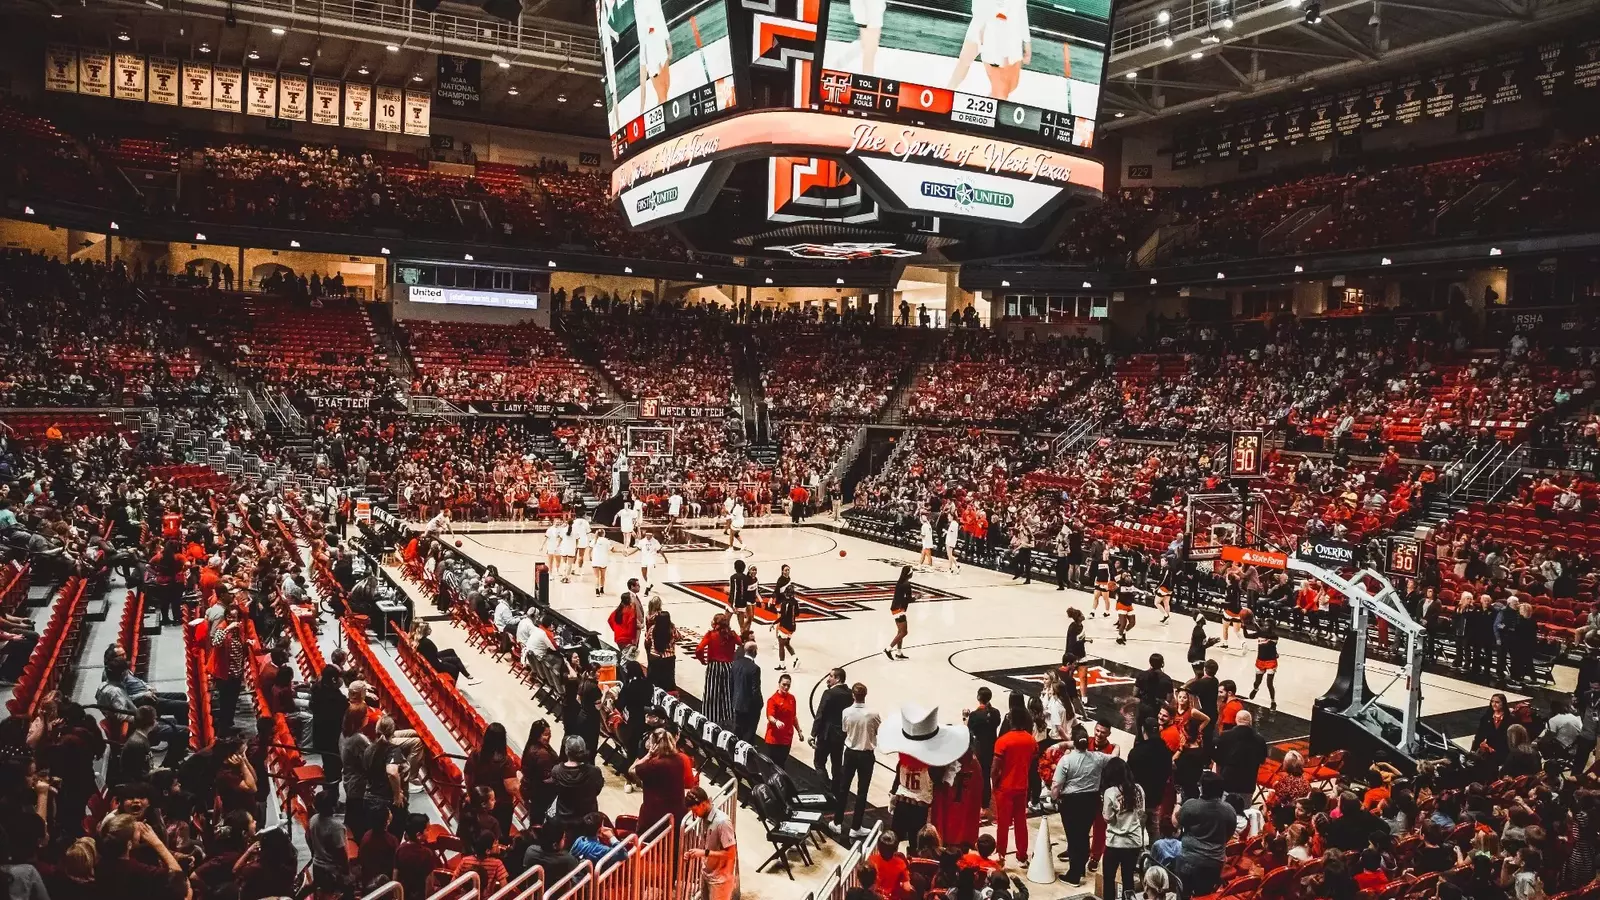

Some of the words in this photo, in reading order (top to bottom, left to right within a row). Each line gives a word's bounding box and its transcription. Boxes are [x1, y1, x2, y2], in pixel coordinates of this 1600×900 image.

[1540, 49, 1561, 60] SHARP
[441, 82, 476, 93] NATIONAL
[859, 79, 872, 88] TOL
[887, 83, 893, 92] 4
[437, 90, 479, 101] CHAMPIONS
[692, 92, 697, 101] 4
[703, 88, 712, 96] TOL
[856, 93, 872, 101] TEAM
[1496, 89, 1519, 98] SWEET
[378, 94, 400, 102] BURNESS
[853, 99, 873, 107] FOULS
[885, 99, 891, 108] 0
[920, 89, 933, 107] 0
[1492, 95, 1521, 105] SIXTEEN
[383, 105, 395, 117] 16
[672, 100, 680, 118] 0
[966, 98, 993, 113] 2:29
[1461, 104, 1483, 113] CHAMPS
[649, 109, 663, 124] 2:29
[694, 107, 698, 116] 0
[1013, 107, 1025, 124] 0
[1046, 113, 1051, 121] 4
[965, 115, 988, 125] PERIOD
[1061, 117, 1071, 125] TOL
[633, 122, 639, 137] 0
[1044, 128, 1049, 136] 0
[687, 133, 720, 167] Texas
[846, 124, 886, 154] The
[890, 130, 951, 162] Spirit
[955, 145, 979, 167] of
[984, 143, 1029, 173] West
[1029, 153, 1071, 181] Texas
[582, 154, 597, 164] 226
[1132, 168, 1148, 176] 229
[924, 183, 955, 197] FIRST
[975, 191, 1011, 205] UNITED
[638, 198, 650, 211] FIRST
[657, 189, 677, 205] UNITED
[412, 288, 442, 297] United
[313, 397, 342, 407] TEXAS
[347, 398, 370, 408] TECH
[660, 407, 686, 415] WRECK
[689, 407, 702, 416] 'EM
[705, 408, 724, 417] TECH
[1239, 436, 1258, 448] 2:29
[1236, 449, 1254, 471] 30
[1315, 544, 1352, 559] OVERTON
[1397, 544, 1417, 556] 2:29
[1252, 554, 1267, 562] State
[1268, 557, 1284, 565] Farm
[1396, 556, 1412, 570] 30
[1323, 575, 1346, 591] LEGACY
[1378, 609, 1406, 628] SPORTS
[906, 773, 920, 790] 16
